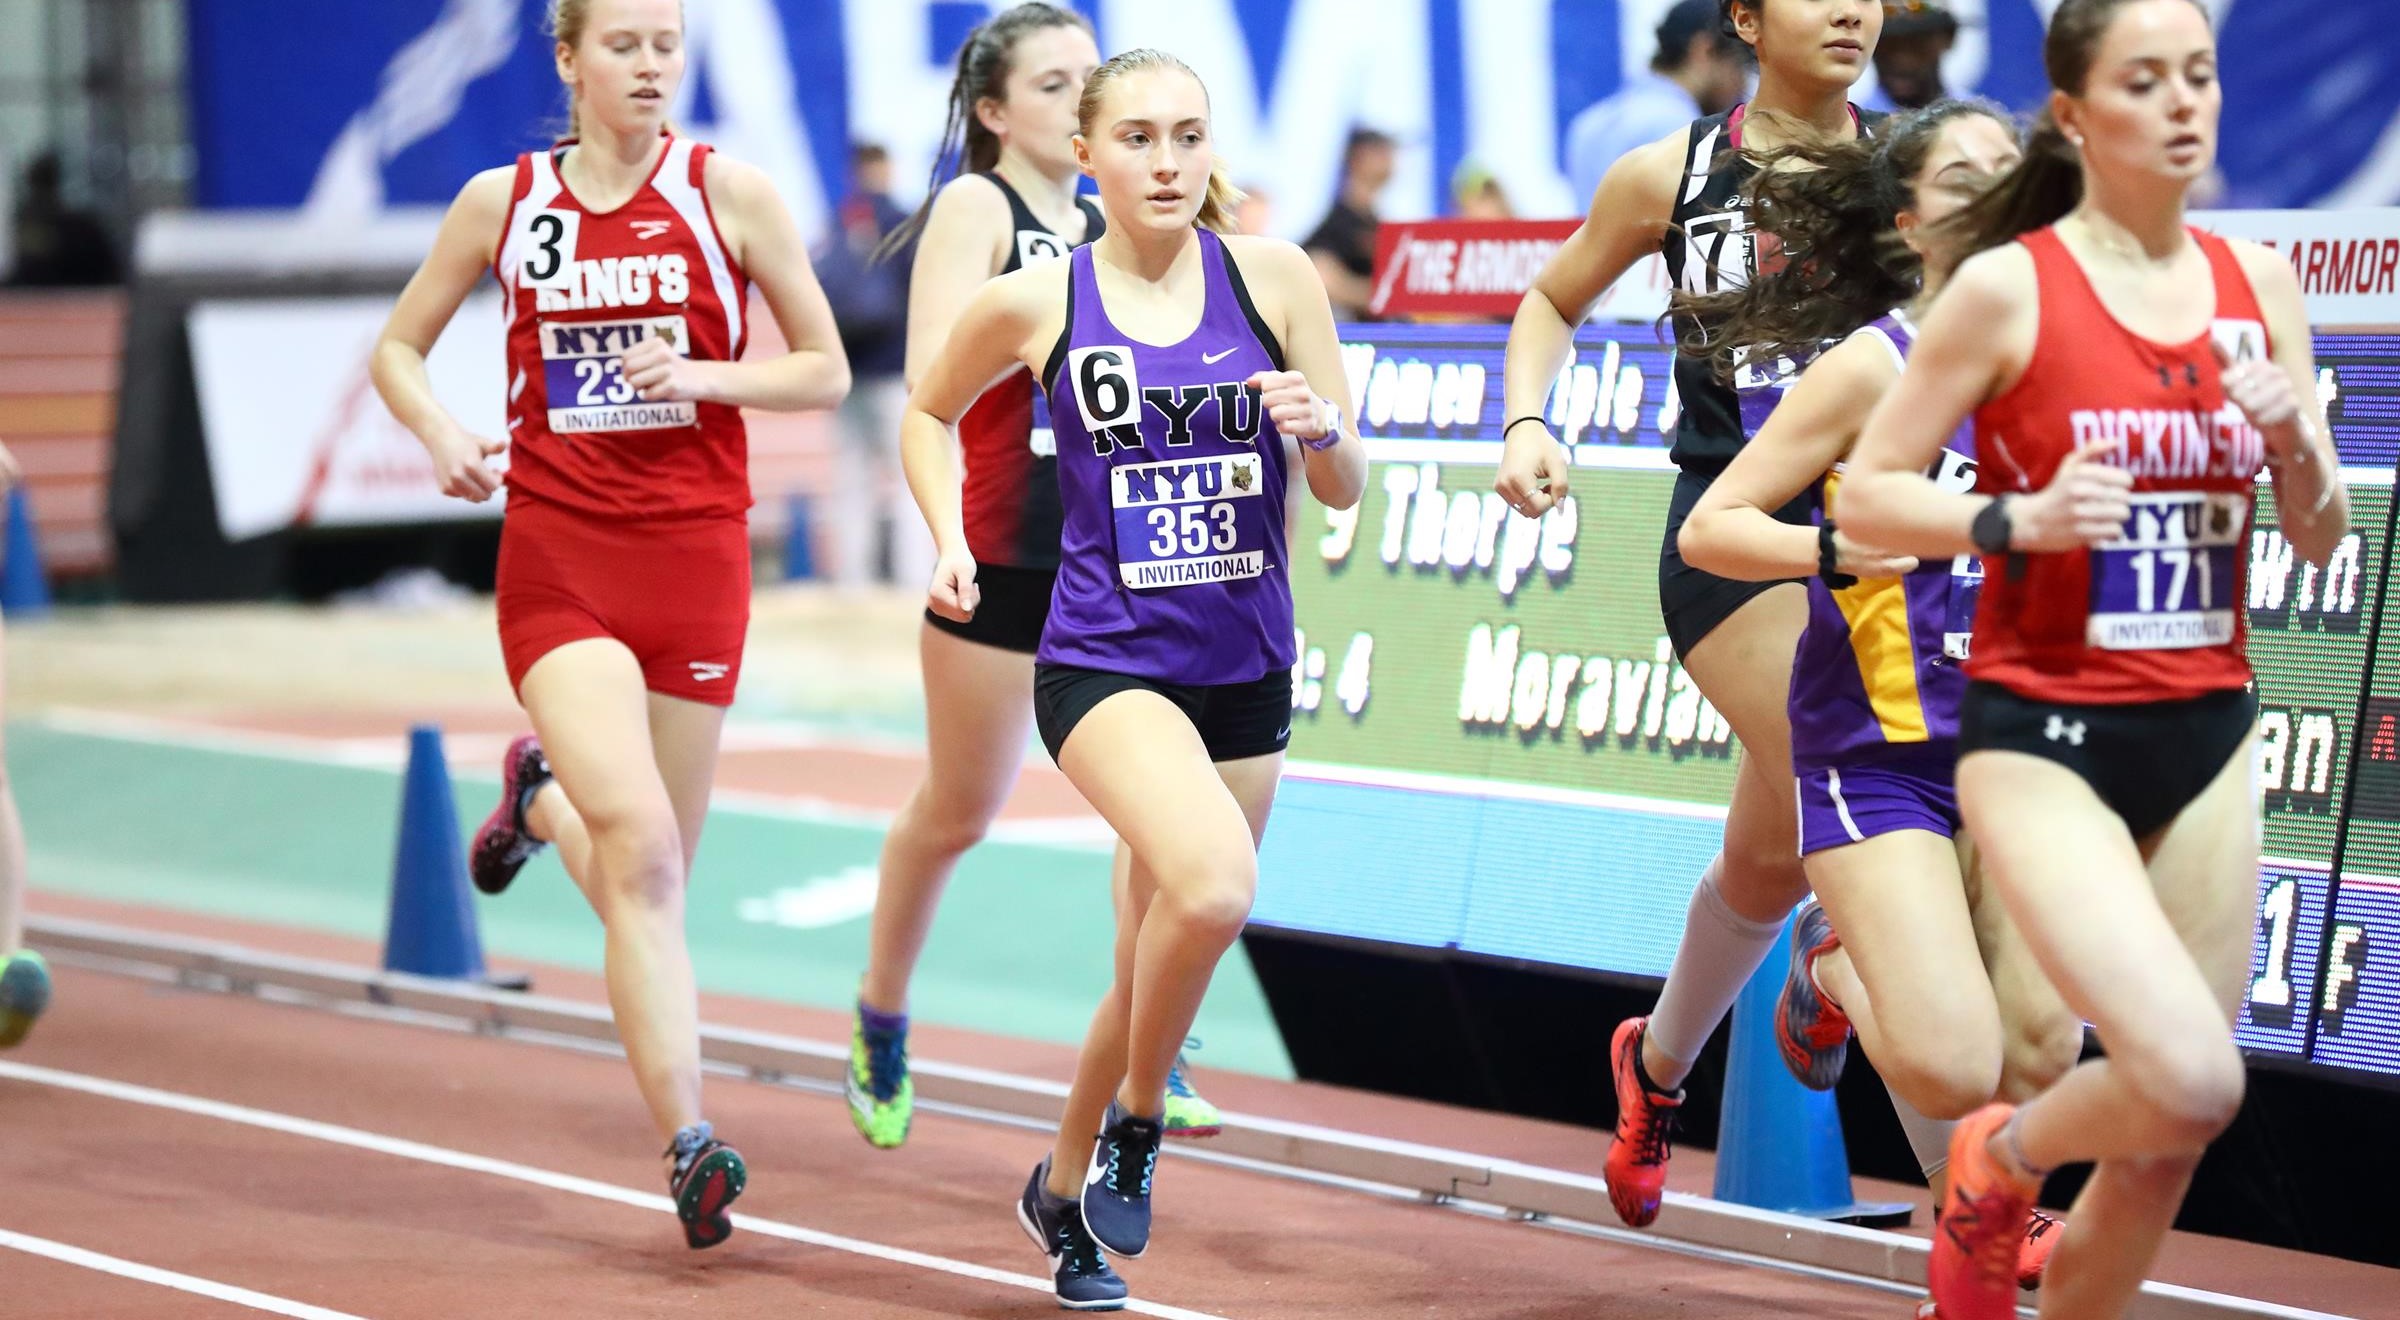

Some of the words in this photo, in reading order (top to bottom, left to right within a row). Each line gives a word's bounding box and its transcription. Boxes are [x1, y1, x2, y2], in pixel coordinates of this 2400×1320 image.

[526, 214, 564, 281] 3
[1406, 239, 1458, 295] THE
[1454, 239, 1566, 294] ARMOR
[574, 358, 646, 406] 23
[1080, 351, 1130, 422] 6
[1551, 340, 1644, 446] iple
[565, 407, 684, 429] INVITATIONAL
[1125, 461, 1223, 503] NYU
[1147, 502, 1237, 558] 353
[1380, 462, 1578, 595] Thorpe
[1138, 556, 1255, 585] INVITATIONAL
[2129, 550, 2213, 612] 171
[2111, 618, 2222, 642] INVITATIONA
[1336, 631, 1374, 715] 4
[1459, 622, 1732, 745] Moravian
[2251, 879, 2296, 1006] 1
[2323, 924, 2363, 1011] F
